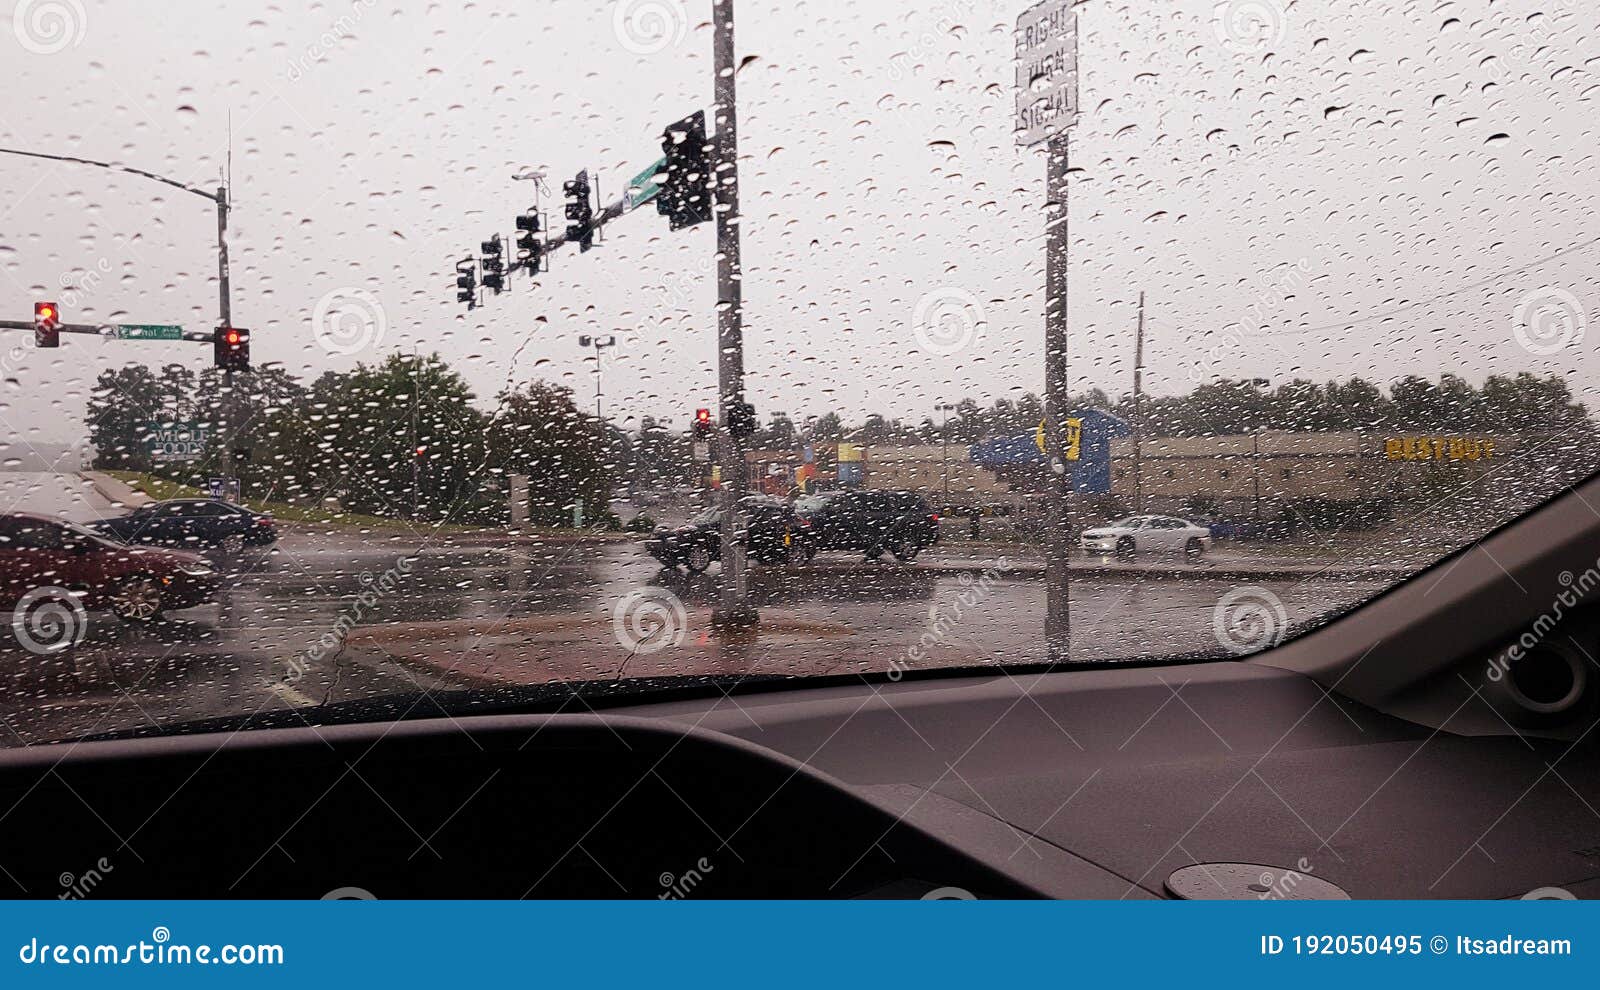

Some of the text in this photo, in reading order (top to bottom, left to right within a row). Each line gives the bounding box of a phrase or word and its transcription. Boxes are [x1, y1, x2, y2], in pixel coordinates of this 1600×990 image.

[1026, 4, 1068, 51] RIGHT
[152, 429, 208, 442] WHOLE
[1385, 437, 1446, 460] BEST
